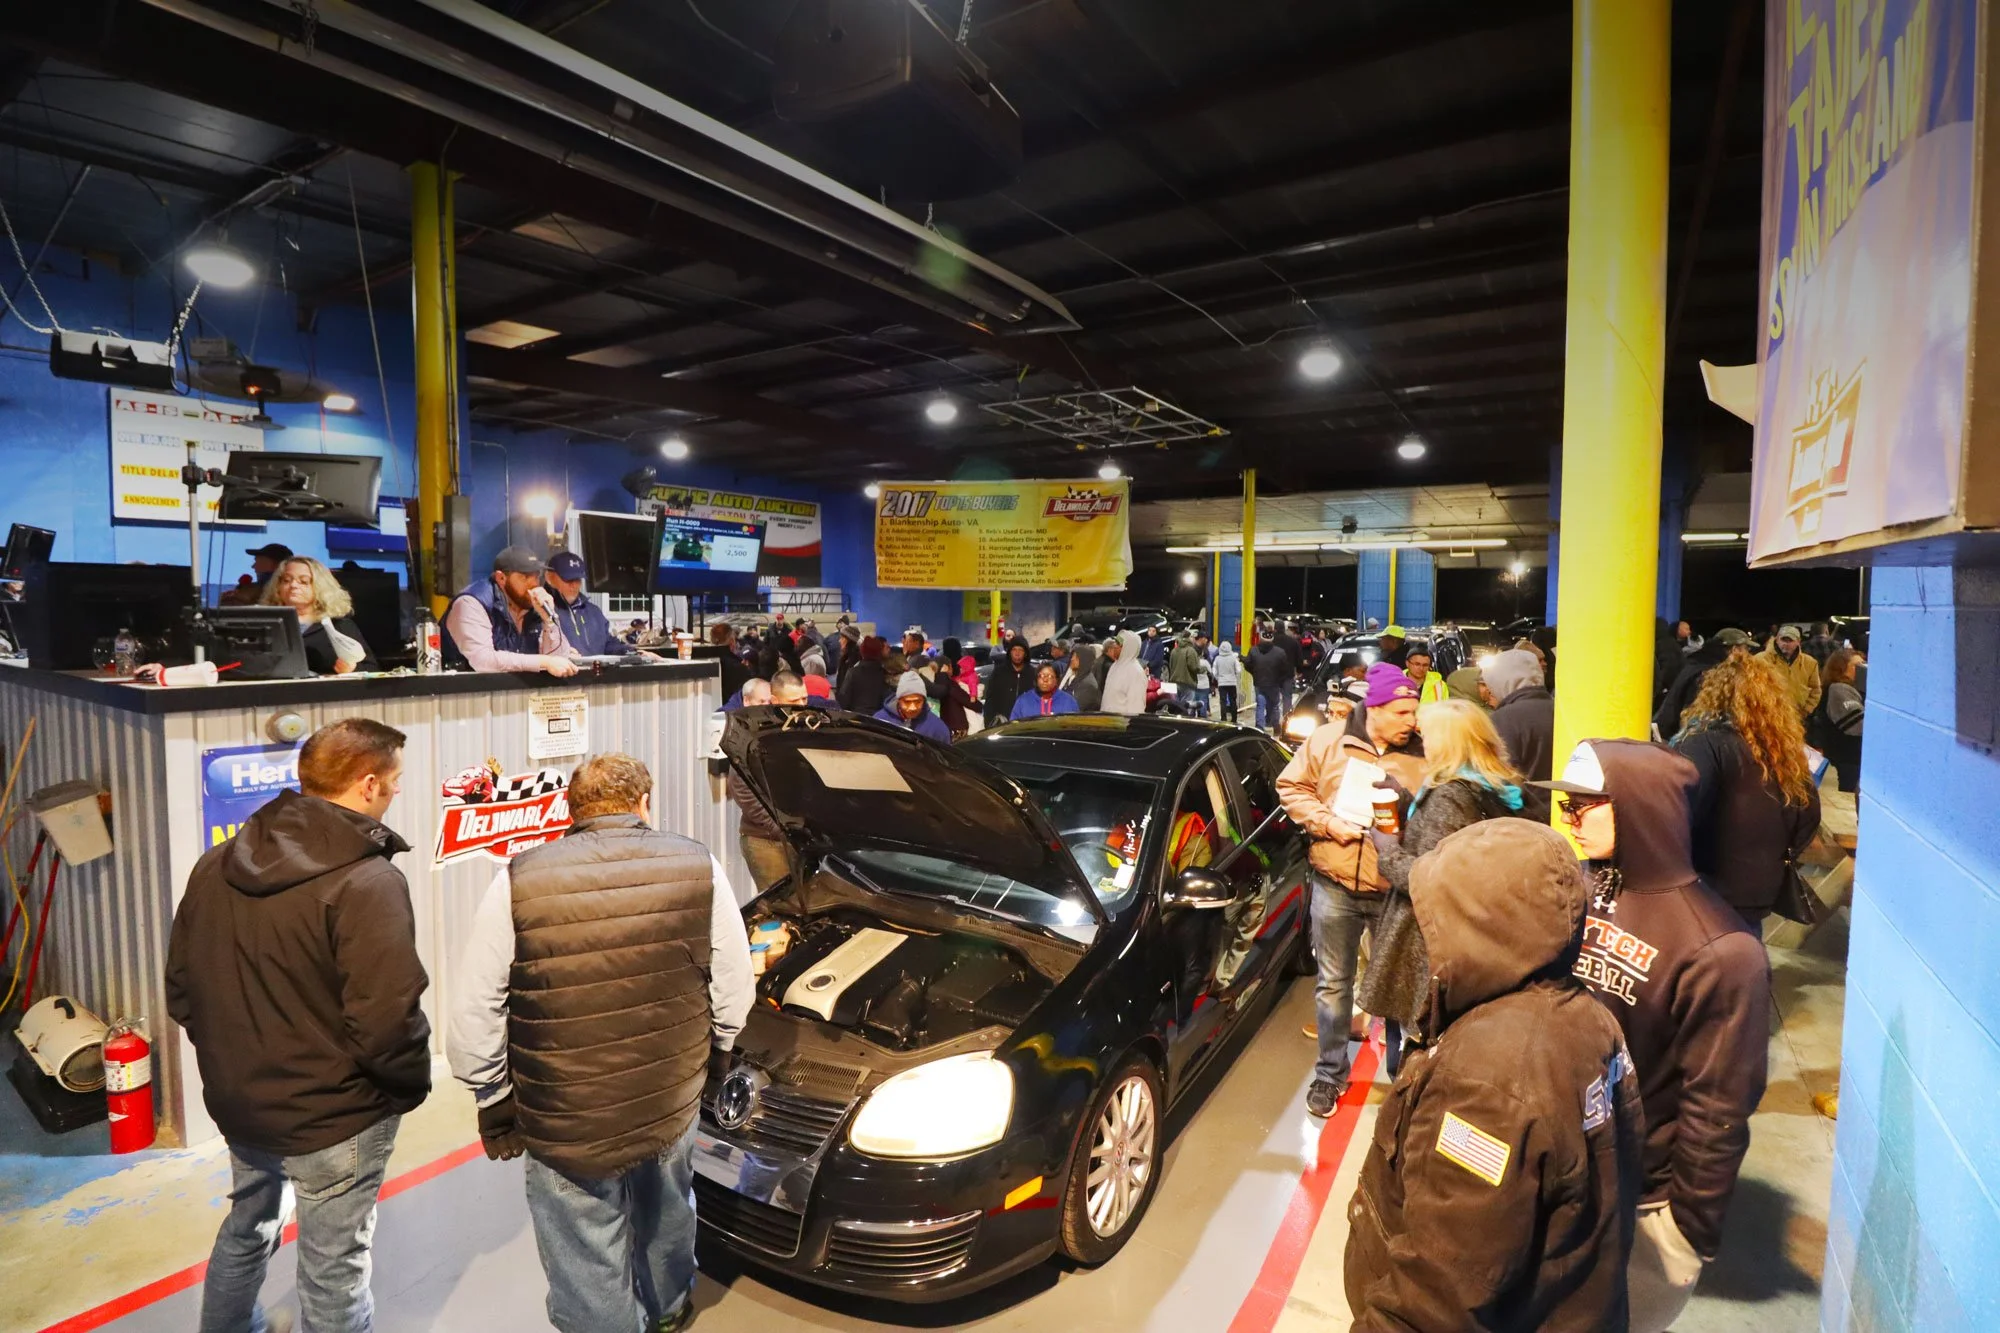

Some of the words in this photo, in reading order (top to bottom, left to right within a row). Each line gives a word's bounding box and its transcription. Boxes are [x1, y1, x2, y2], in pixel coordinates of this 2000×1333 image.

[120, 465, 147, 476] TITLE
[150, 468, 179, 479] DELAY
[123, 495, 180, 508] ANNOUCEMENT
[710, 492, 754, 511] AUTO
[754, 498, 817, 518] AUCTION
[880, 490, 937, 518] 2017
[934, 495, 957, 511] TOP
[1053, 499, 1091, 512] DELAWARE
[1088, 499, 1112, 513] AUTO
[231, 759, 299, 787] Hert
[270, 781, 301, 789] AUTOMO
[539, 792, 569, 829] AU
